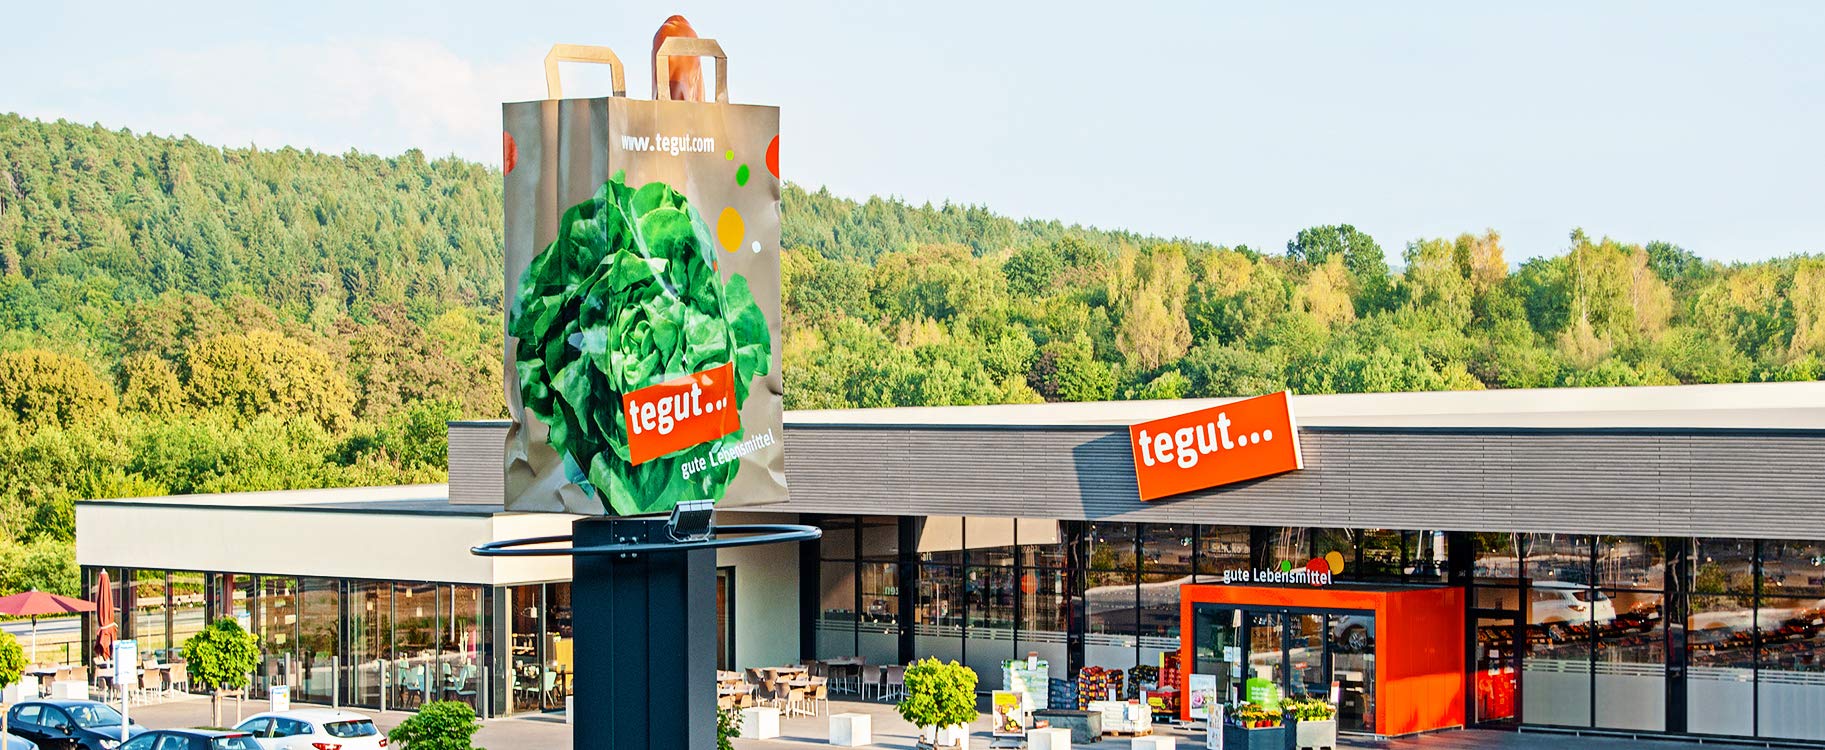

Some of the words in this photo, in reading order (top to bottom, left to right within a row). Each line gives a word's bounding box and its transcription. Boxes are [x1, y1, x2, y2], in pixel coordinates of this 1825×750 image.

[621, 133, 715, 156] www.tegut.com
[629, 382, 727, 435] tegut...
[681, 457, 707, 480] gute
[708, 428, 776, 467] Lebensmittel
[1138, 411, 1273, 469] tegut...
[1223, 568, 1250, 584] gute
[1253, 567, 1332, 585] Lebensmittel
